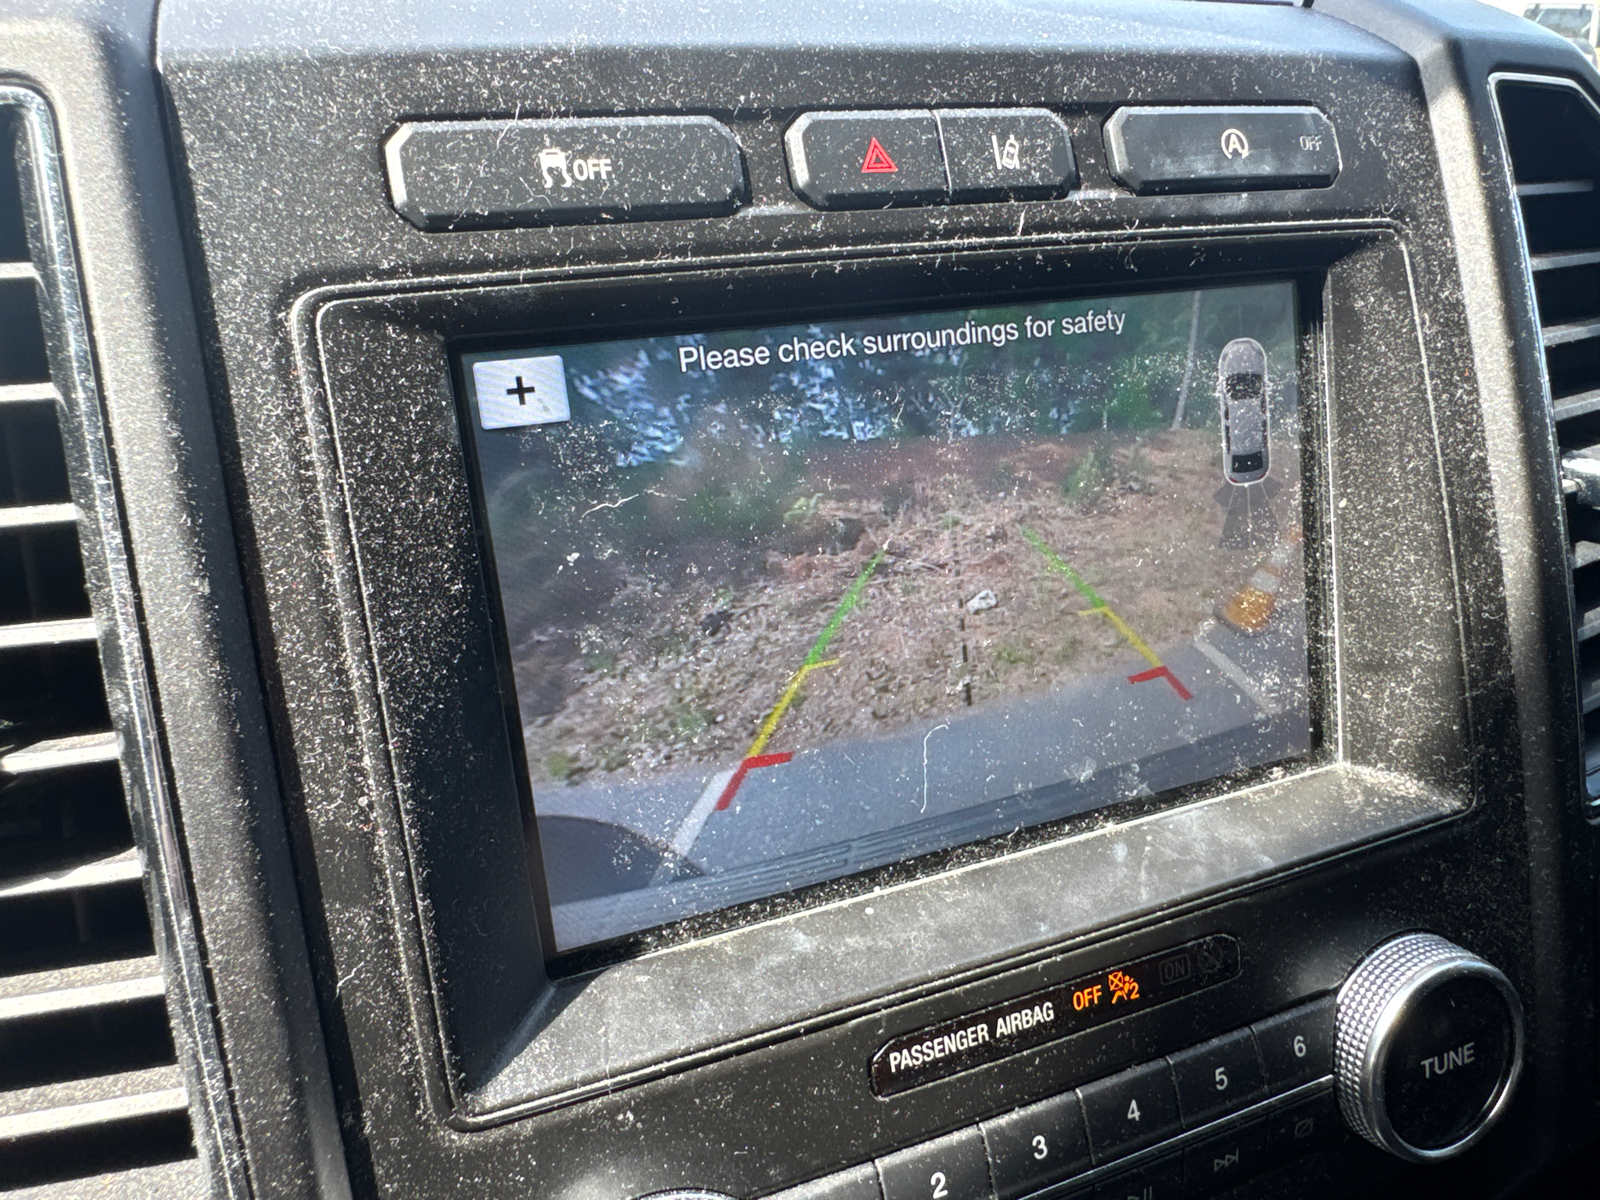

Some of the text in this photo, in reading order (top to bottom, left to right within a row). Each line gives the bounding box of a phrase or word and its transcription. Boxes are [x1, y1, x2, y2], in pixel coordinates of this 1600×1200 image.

[1300, 134, 1322, 151] OFF
[573, 158, 612, 181] OFF
[678, 309, 1126, 373] Please check surroundings for safety
[889, 1022, 990, 1073] PASSENGER
[995, 1001, 1055, 1038] AIRBAG
[1072, 984, 1102, 1011] OFF
[1164, 958, 1186, 980] ON
[1293, 1035, 1307, 1057] 6
[1420, 1042, 1476, 1079] TUNE
[1214, 1067, 1229, 1090] 5
[1126, 1099, 1141, 1122] 4
[1031, 1135, 1048, 1160] 3
[930, 1171, 949, 1198] 2
